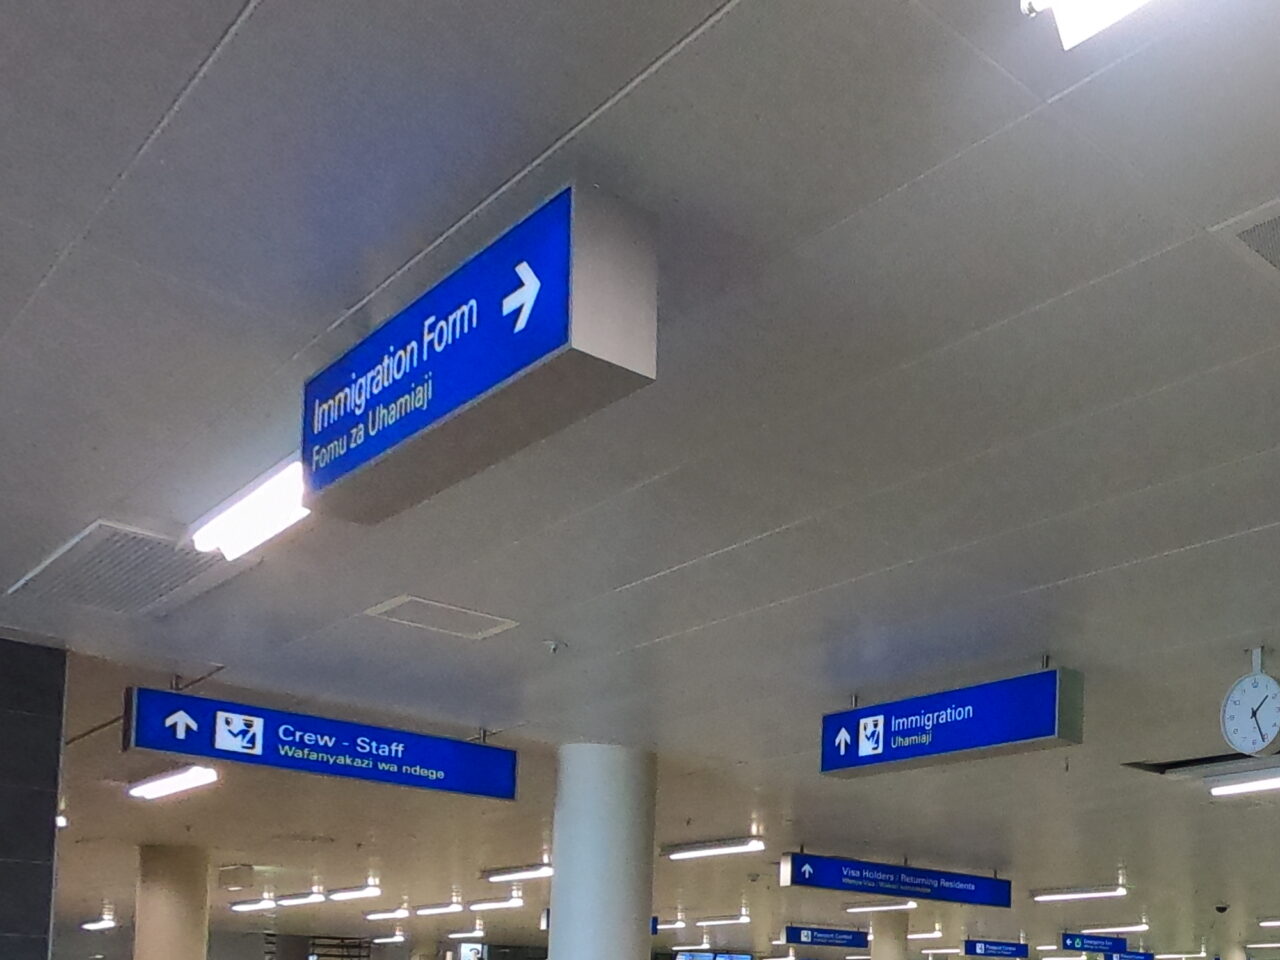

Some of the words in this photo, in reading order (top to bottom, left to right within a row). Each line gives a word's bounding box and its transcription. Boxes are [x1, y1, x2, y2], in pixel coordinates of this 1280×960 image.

[314, 340, 417, 434] Immigration
[422, 298, 478, 362] Form
[312, 434, 348, 472] Fomu
[349, 421, 365, 450] za
[368, 372, 432, 436] Uhamiaji
[890, 705, 974, 731] Immigration
[277, 724, 336, 748] Crew
[355, 736, 406, 759] Staff
[890, 730, 933, 749] Uhamiaji
[278, 745, 374, 769] Wafanyakazi
[377, 762, 398, 773] wa
[402, 763, 445, 781] ndege
[842, 866, 860, 878] Visa
[862, 868, 894, 881] Holders
[901, 873, 938, 887] Returning
[940, 878, 976, 891] Residents
